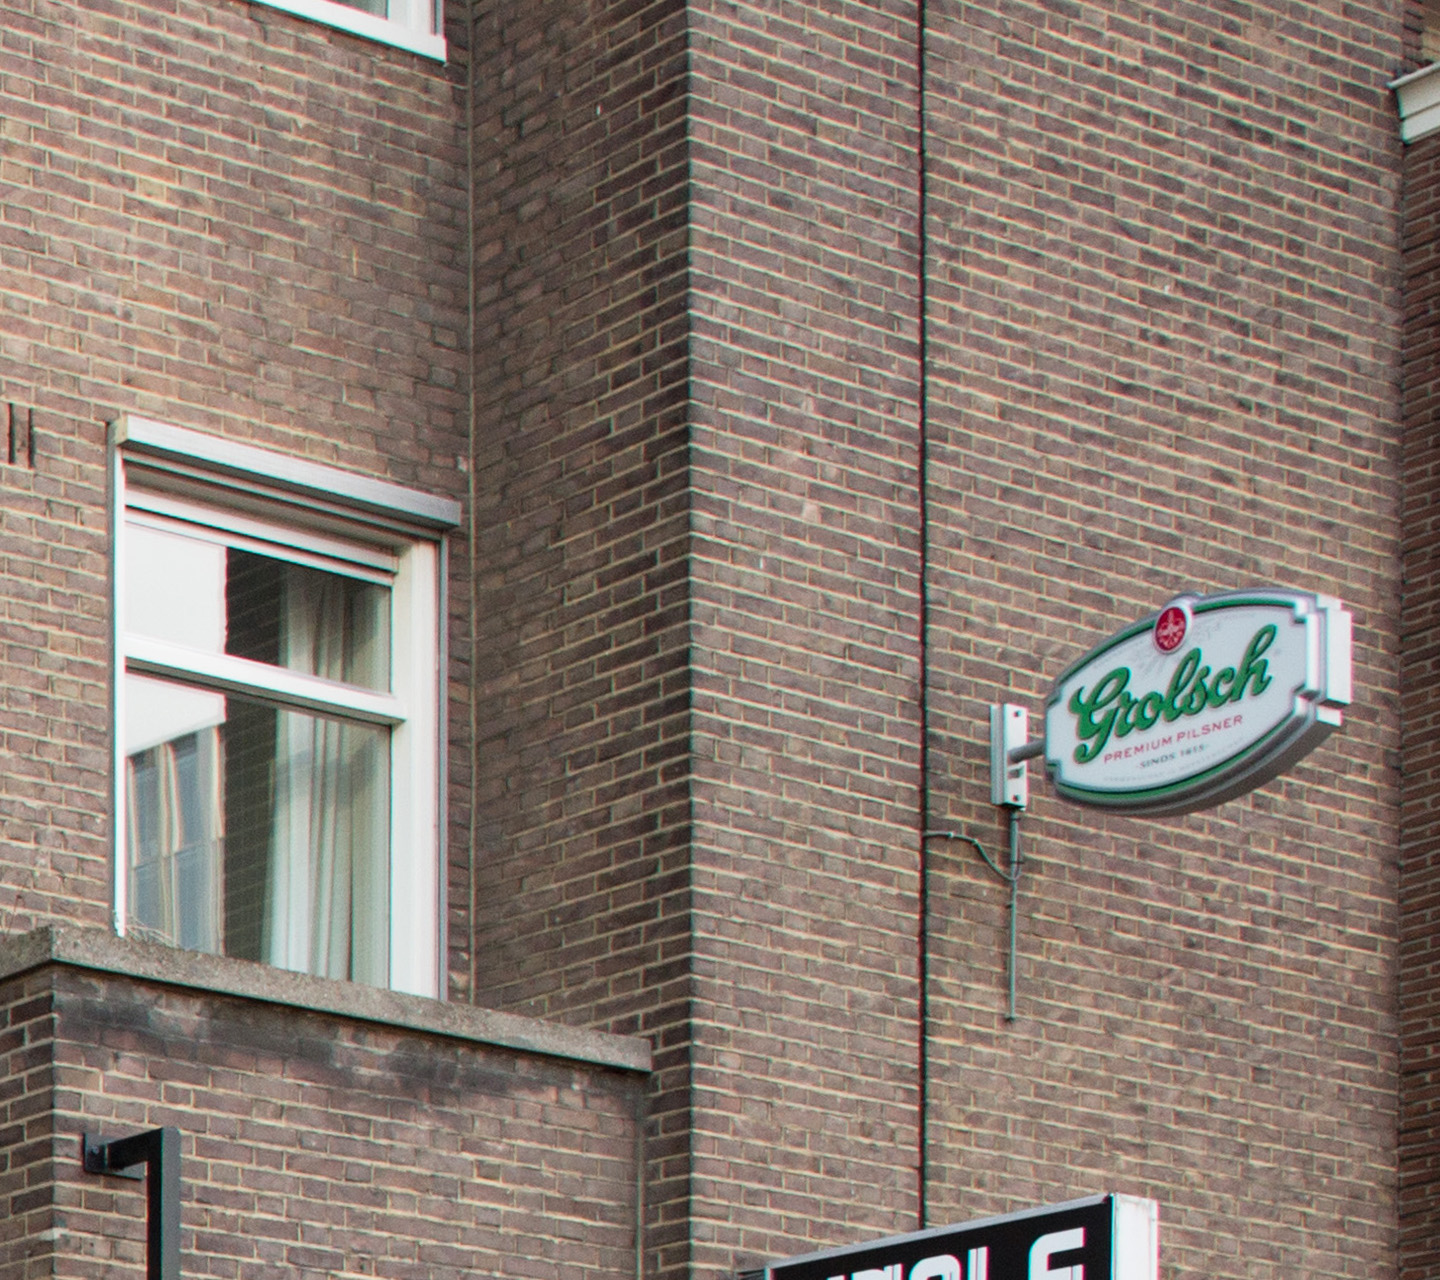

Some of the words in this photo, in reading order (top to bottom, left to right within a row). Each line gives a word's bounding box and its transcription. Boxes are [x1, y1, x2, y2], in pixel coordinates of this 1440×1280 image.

[1068, 624, 1278, 764] Grolsch
[1103, 735, 1173, 766] PREMIUM
[1176, 714, 1244, 743] PILSNER
